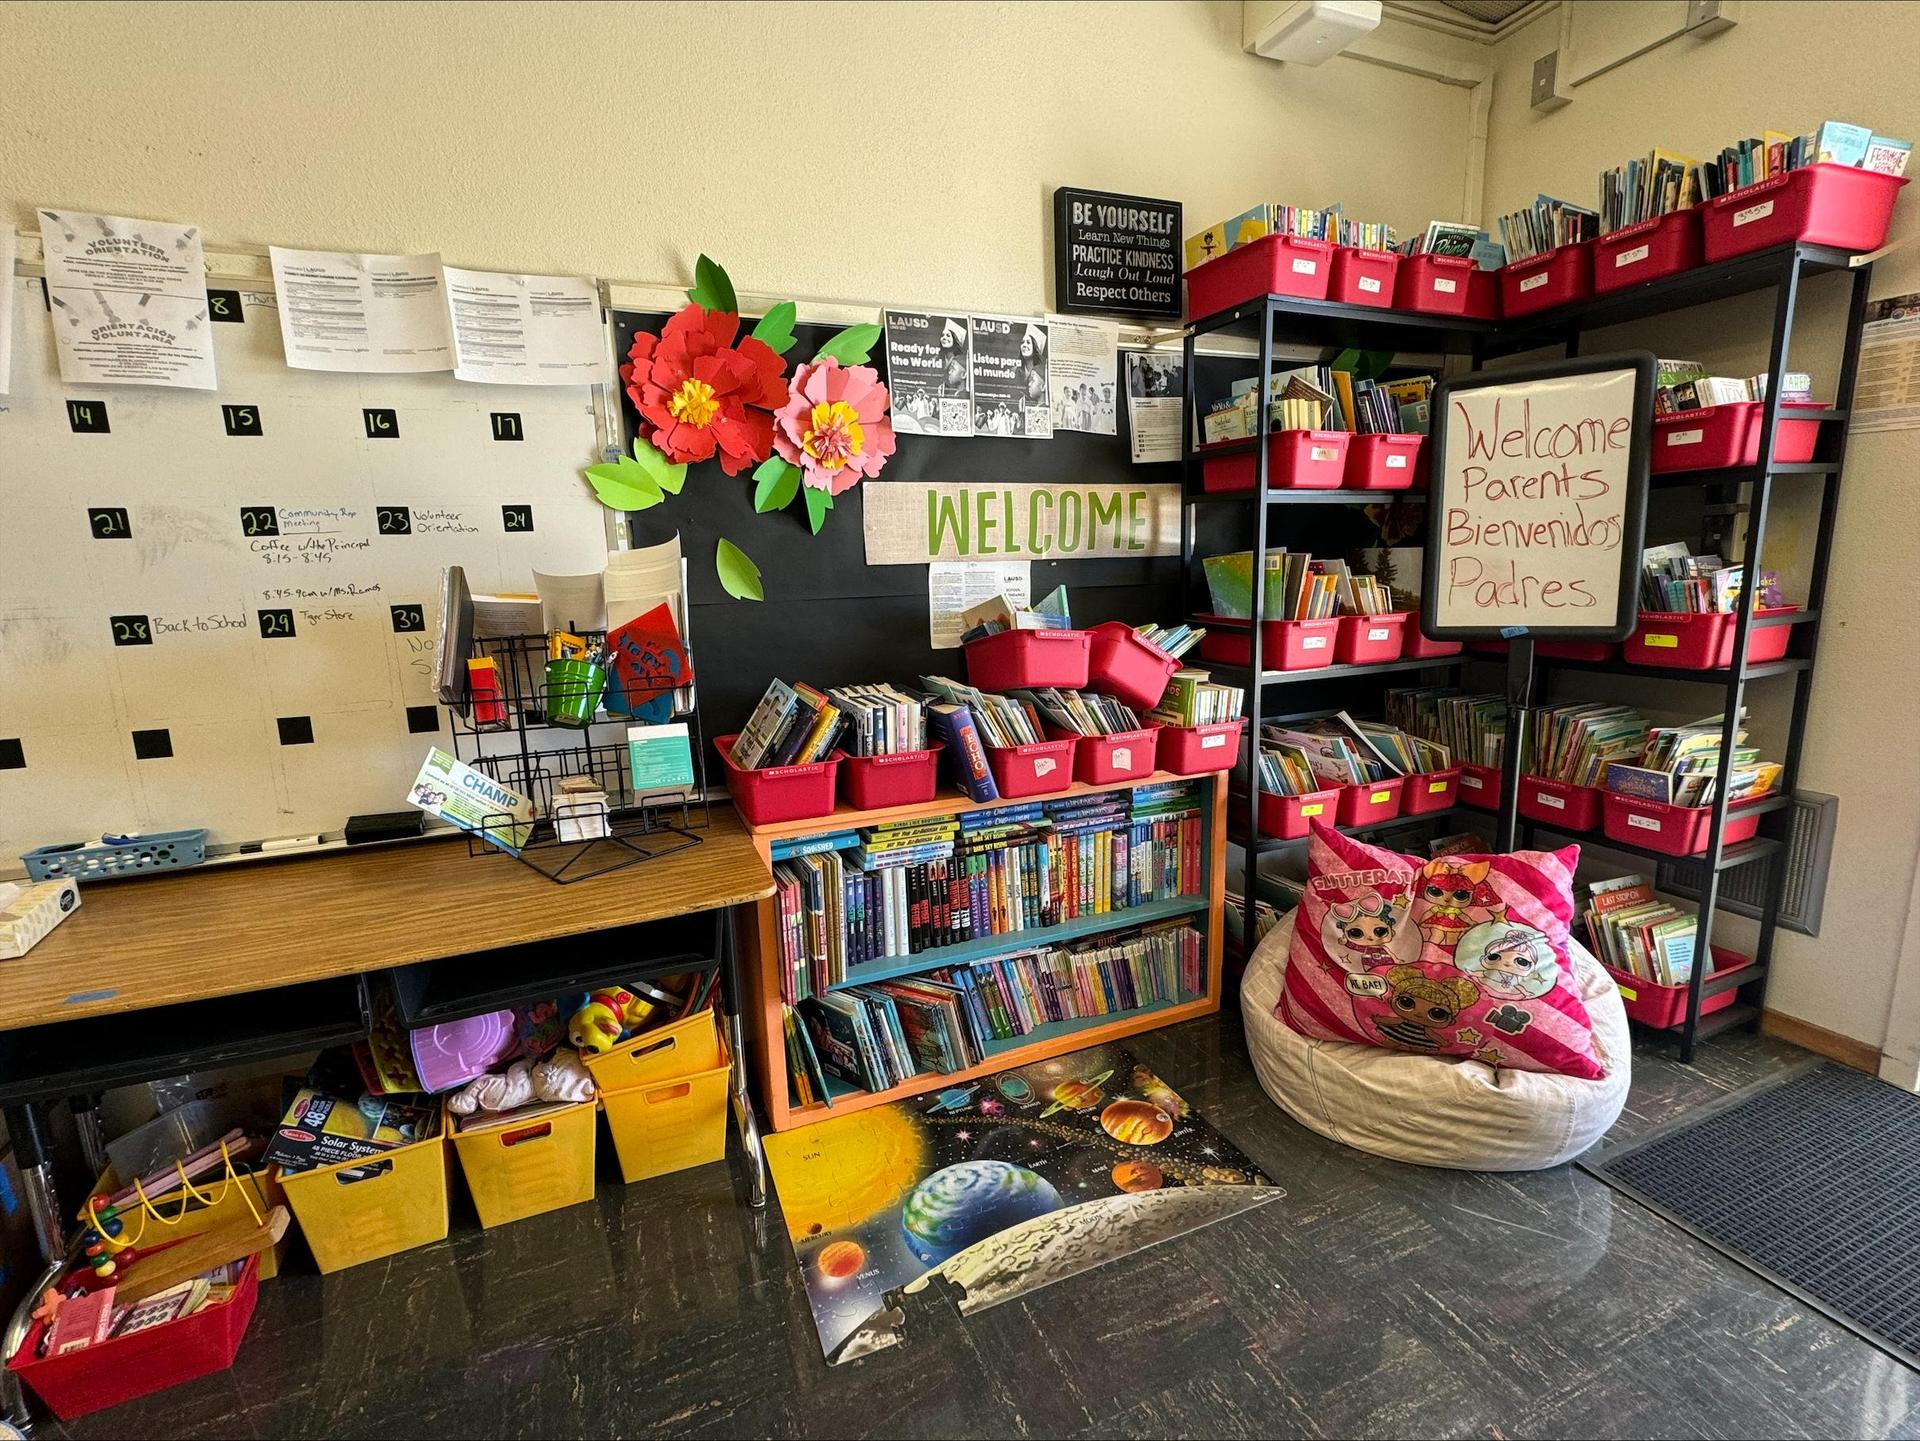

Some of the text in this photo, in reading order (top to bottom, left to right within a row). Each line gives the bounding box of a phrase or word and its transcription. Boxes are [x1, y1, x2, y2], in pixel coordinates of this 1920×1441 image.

[1727, 179, 1780, 201] SCHOLASTIC
[1072, 202, 1174, 235] BE YOURSELF
[1611, 222, 1654, 240] SCHOLASTIC
[88, 238, 164, 256] VOLUNTEER
[1078, 229, 1170, 250] Learn New Things
[1298, 239, 1328, 249] SCHOLASTIC
[85, 246, 170, 262] ORIENTATION
[1072, 244, 1174, 270] PRACTICE KINDNESS
[1366, 252, 1394, 260] SCHOLASTIC
[1441, 258, 1468, 266] SCHOLASTIC
[1514, 253, 1550, 270] SCHOLASTIC
[1074, 263, 1175, 285] Laugh Out Loud
[1076, 282, 1171, 303] Respect Others
[888, 316, 928, 328] LAUSD
[973, 320, 1010, 334] LAUSD
[91, 322, 176, 341] ORIENTACIÓN
[92, 330, 173, 345] VOLUNTARIA
[890, 342, 941, 356] Ready for
[891, 356, 942, 369] the World
[974, 353, 1022, 368] Listos para
[974, 368, 1016, 378] el mundo
[72, 404, 93, 424] 14
[229, 408, 254, 429] 15
[1661, 410, 1707, 422] SCHOLASTIC
[368, 413, 390, 432] 16
[496, 415, 517, 436] 17
[1455, 397, 1631, 461] Welcome
[1462, 462, 1610, 503] Parents
[93, 512, 124, 534] 21
[242, 512, 277, 534] 22
[278, 508, 339, 522] Community
[378, 510, 409, 531] 23
[412, 510, 463, 521] Volunteer
[504, 512, 526, 528] 24
[927, 488, 1148, 556] WELCOME
[417, 522, 479, 533] Orientation
[1447, 502, 1622, 551] Bienvenidos
[250, 540, 290, 552] Coffee
[1449, 556, 1597, 608] Padres
[152, 613, 248, 634] Back to School
[262, 614, 290, 634] 29
[393, 610, 420, 628] 30
[114, 622, 147, 640] 28
[406, 635, 434, 654] No
[1115, 732, 1148, 740] SCHOLASTIC
[1204, 724, 1236, 732] SCHOLASTIC
[966, 735, 984, 770] ECHO
[1027, 743, 1065, 753] SCHOLASTIC
[885, 753, 926, 763] SCHOLASTIC
[775, 765, 819, 775] SCHOLASTIC
[462, 774, 519, 808] CHAMP
[1620, 797, 1664, 810] SCHOLASTIC
[1313, 869, 1412, 890] GLITTERAT
[1602, 890, 1640, 906] LAST STOP ON
[950, 910, 960, 930] ZERO
[961, 908, 970, 928] ZERO
[1362, 980, 1382, 990] BAE!
[948, 1105, 973, 1115] NEPTUNE
[1020, 1101, 1041, 1110] URANUS
[1077, 1106, 1097, 1115] SATURN
[304, 1112, 326, 1128] 48
[321, 1136, 384, 1155] Solar System
[322, 1146, 340, 1155] PIECE
[802, 1152, 820, 1162] SUN
[1028, 1158, 1048, 1169] EARTH
[1079, 1214, 1102, 1226] MOON
[800, 1230, 832, 1244] MERCURY
[210, 1267, 222, 1278] 17
[856, 1268, 880, 1281] VENUS
